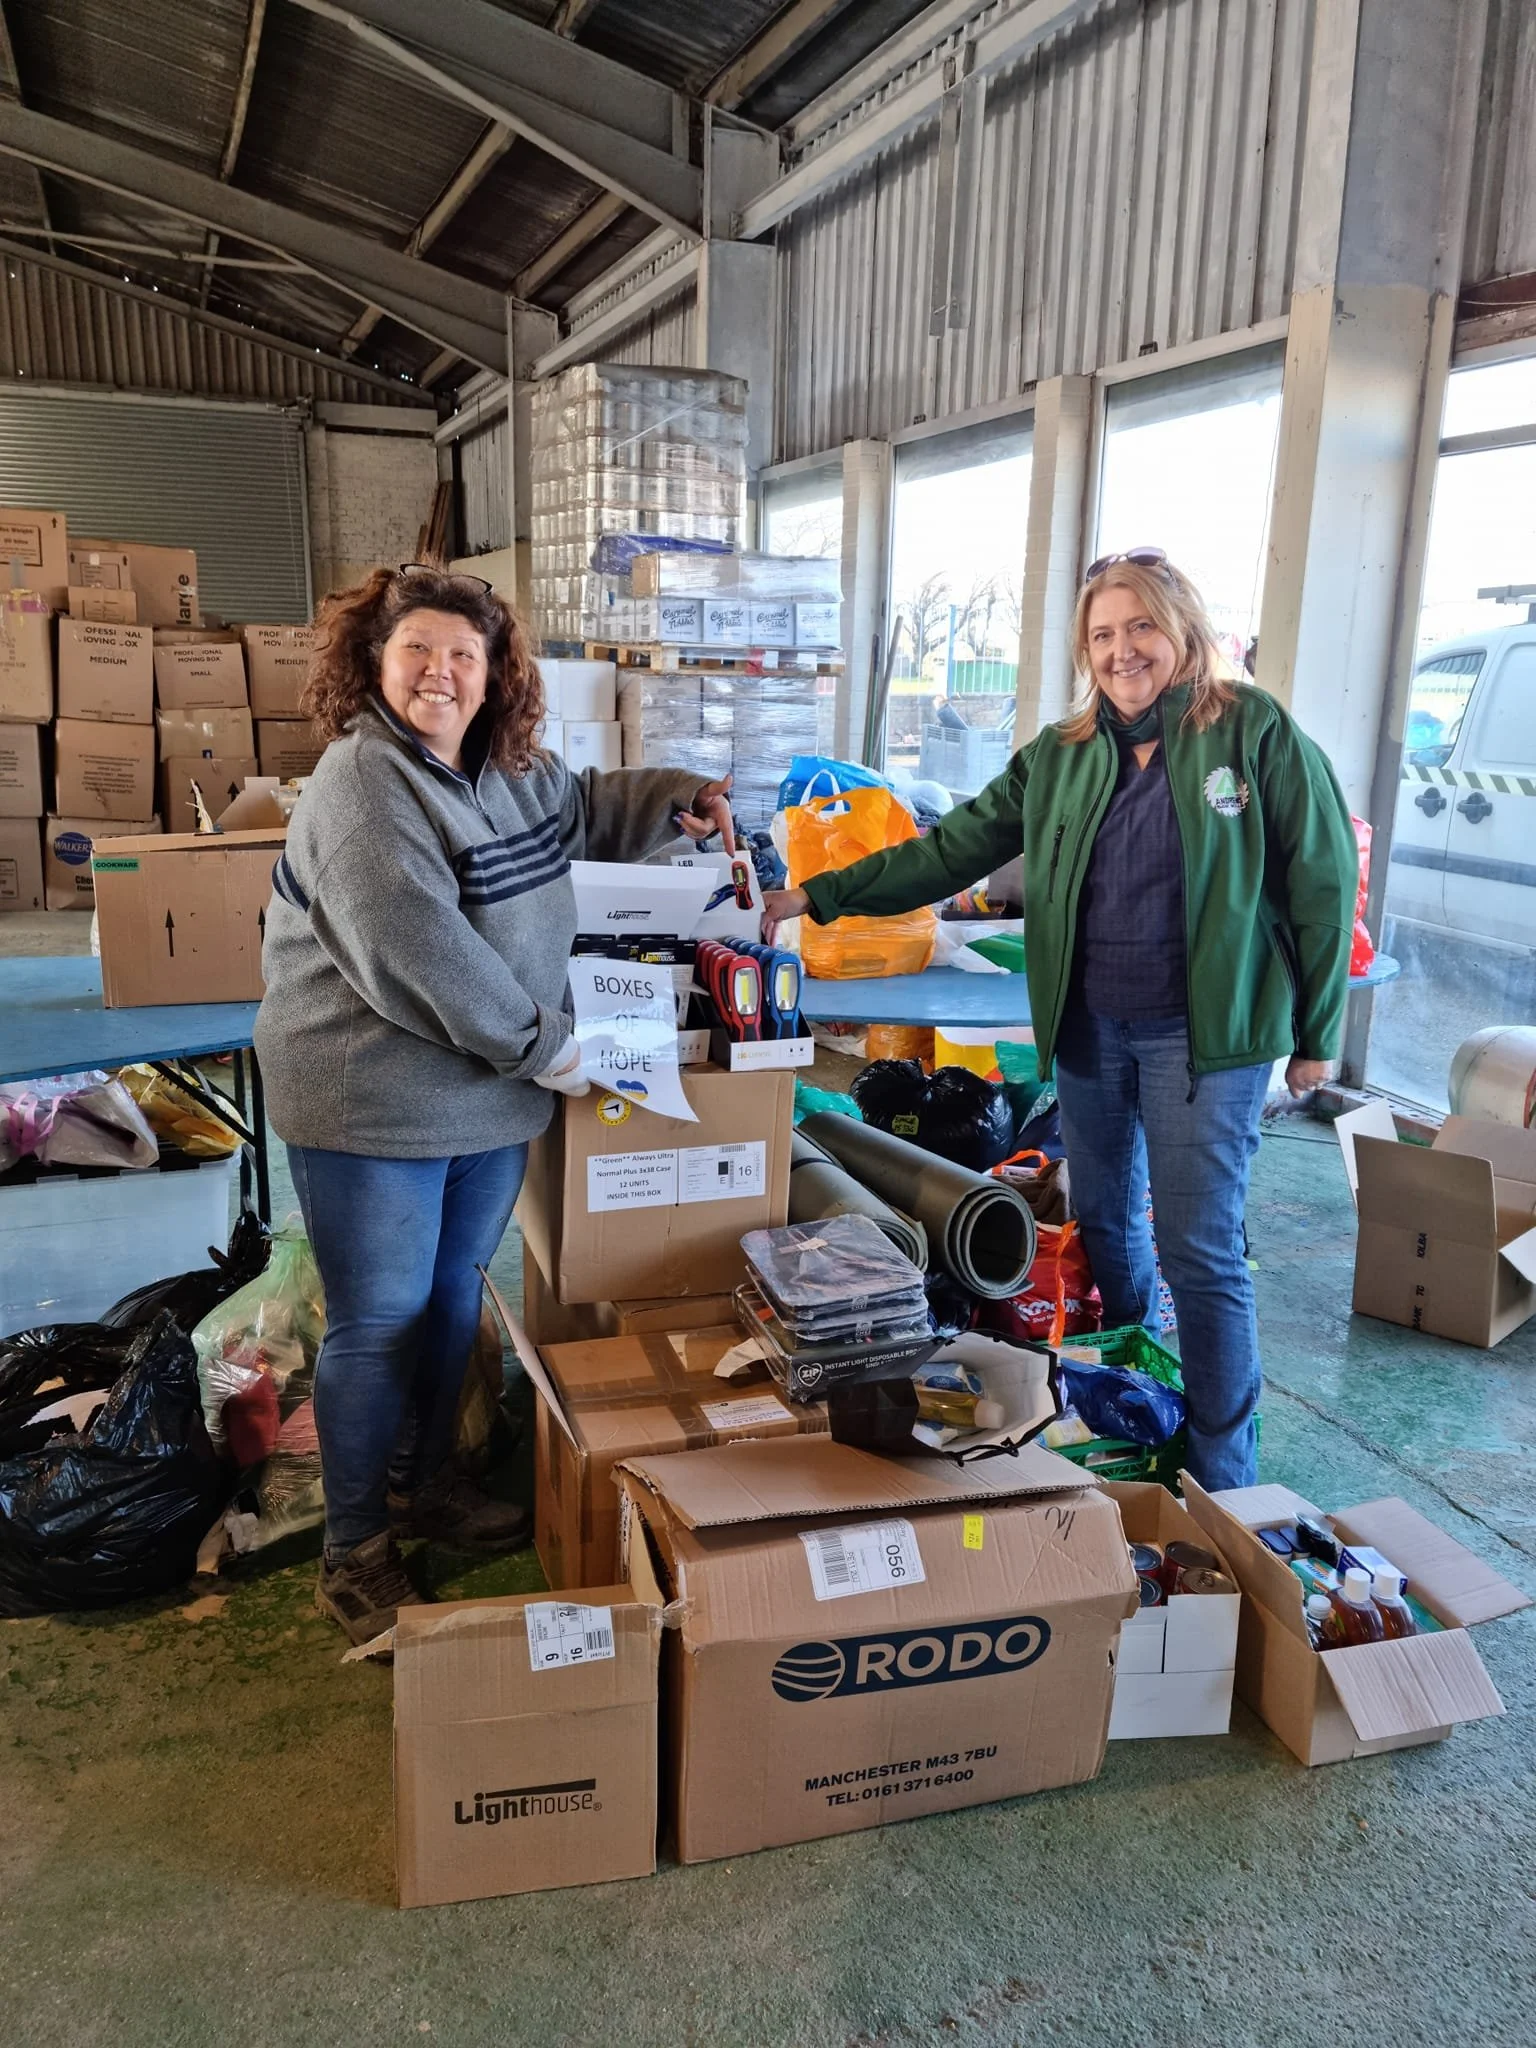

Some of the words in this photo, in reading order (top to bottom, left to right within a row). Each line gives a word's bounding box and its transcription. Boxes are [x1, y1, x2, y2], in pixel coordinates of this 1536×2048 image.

[119, 640, 139, 649] OX
[89, 656, 128, 666] MEDIUM
[593, 975, 655, 999] BOXES
[615, 1014, 640, 1033] OF
[600, 1049, 653, 1073] HOPE
[631, 1154, 656, 1163] Always
[657, 1152, 674, 1160] Ultra
[596, 1169, 622, 1178] Normal
[623, 1167, 638, 1175] Plus
[655, 1165, 672, 1173] Case
[737, 1165, 752, 1177] 16
[619, 1181, 628, 1189] 12
[628, 1179, 650, 1188] UNITS
[606, 1192, 630, 1201] INSIDE
[631, 1190, 646, 1198] THIS
[646, 1189, 662, 1197] BOX
[824, 1361, 851, 1371] INSTANT
[850, 1357, 870, 1366] LIGHT
[869, 1351, 905, 1364] DISPOSABLE
[801, 1367, 819, 1379] ZIP
[885, 1543, 906, 1578] 056
[545, 1652, 560, 1662] 9
[570, 1647, 583, 1661] 16
[856, 1623, 1042, 1685] RODO
[804, 1760, 922, 1792] MANCHESTER
[926, 1753, 959, 1769] M43
[964, 1745, 998, 1763] 7BU
[825, 1792, 859, 1807] TEL:
[862, 1783, 900, 1800] 0161
[903, 1777, 930, 1793] 371
[933, 1769, 975, 1786] 6400
